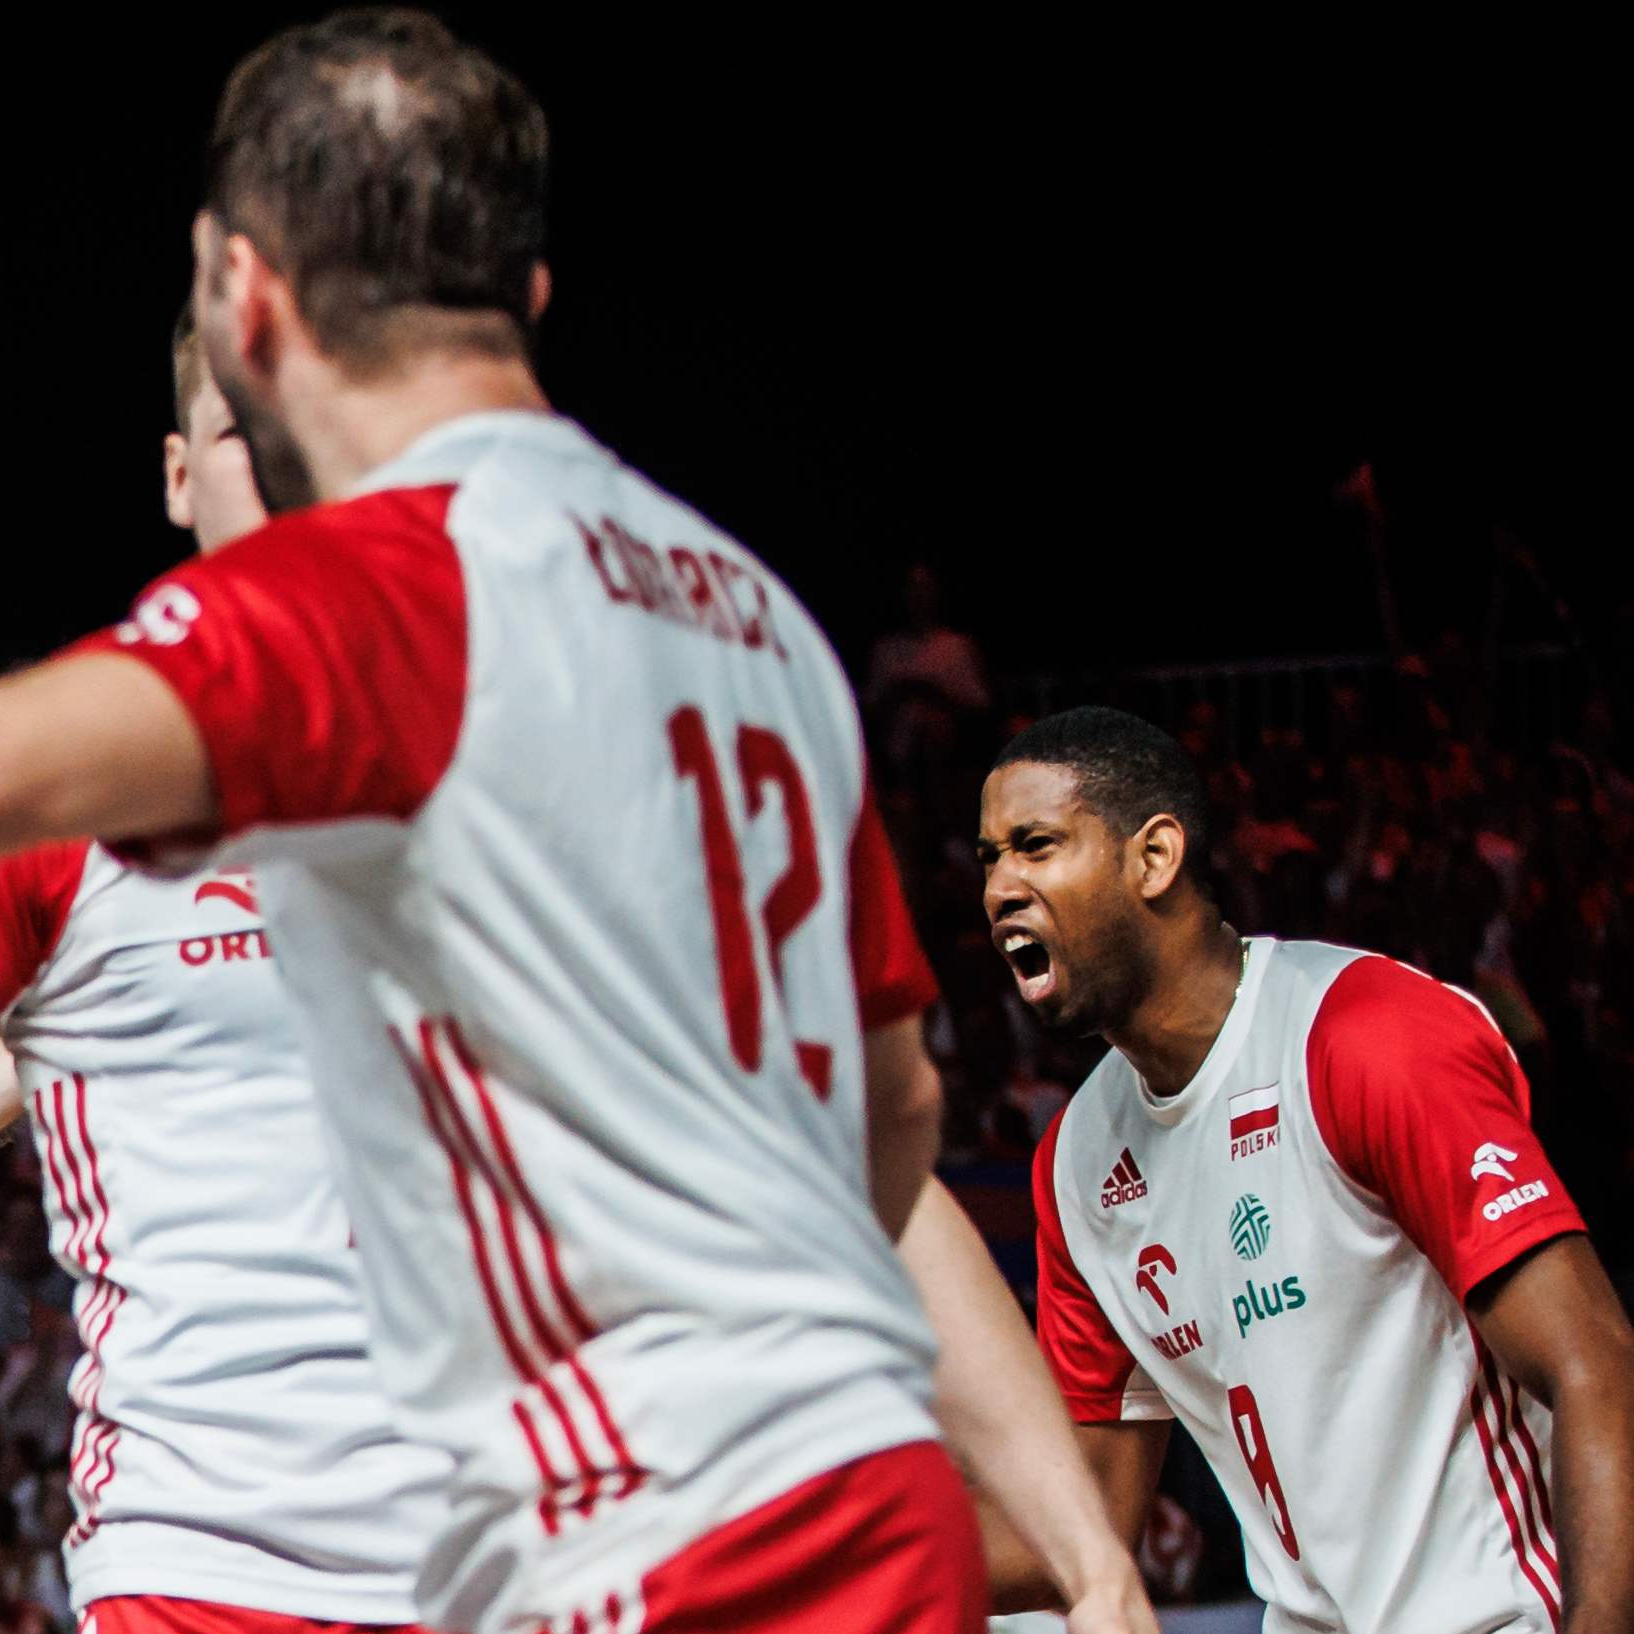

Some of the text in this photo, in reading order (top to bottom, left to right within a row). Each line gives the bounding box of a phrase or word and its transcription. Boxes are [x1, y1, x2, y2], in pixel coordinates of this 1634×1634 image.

[666, 703, 833, 1106] 12
[1100, 1180, 1148, 1209] adidas
[1482, 1179, 1550, 1222] ORLEN
[1232, 1273, 1307, 1339] plus
